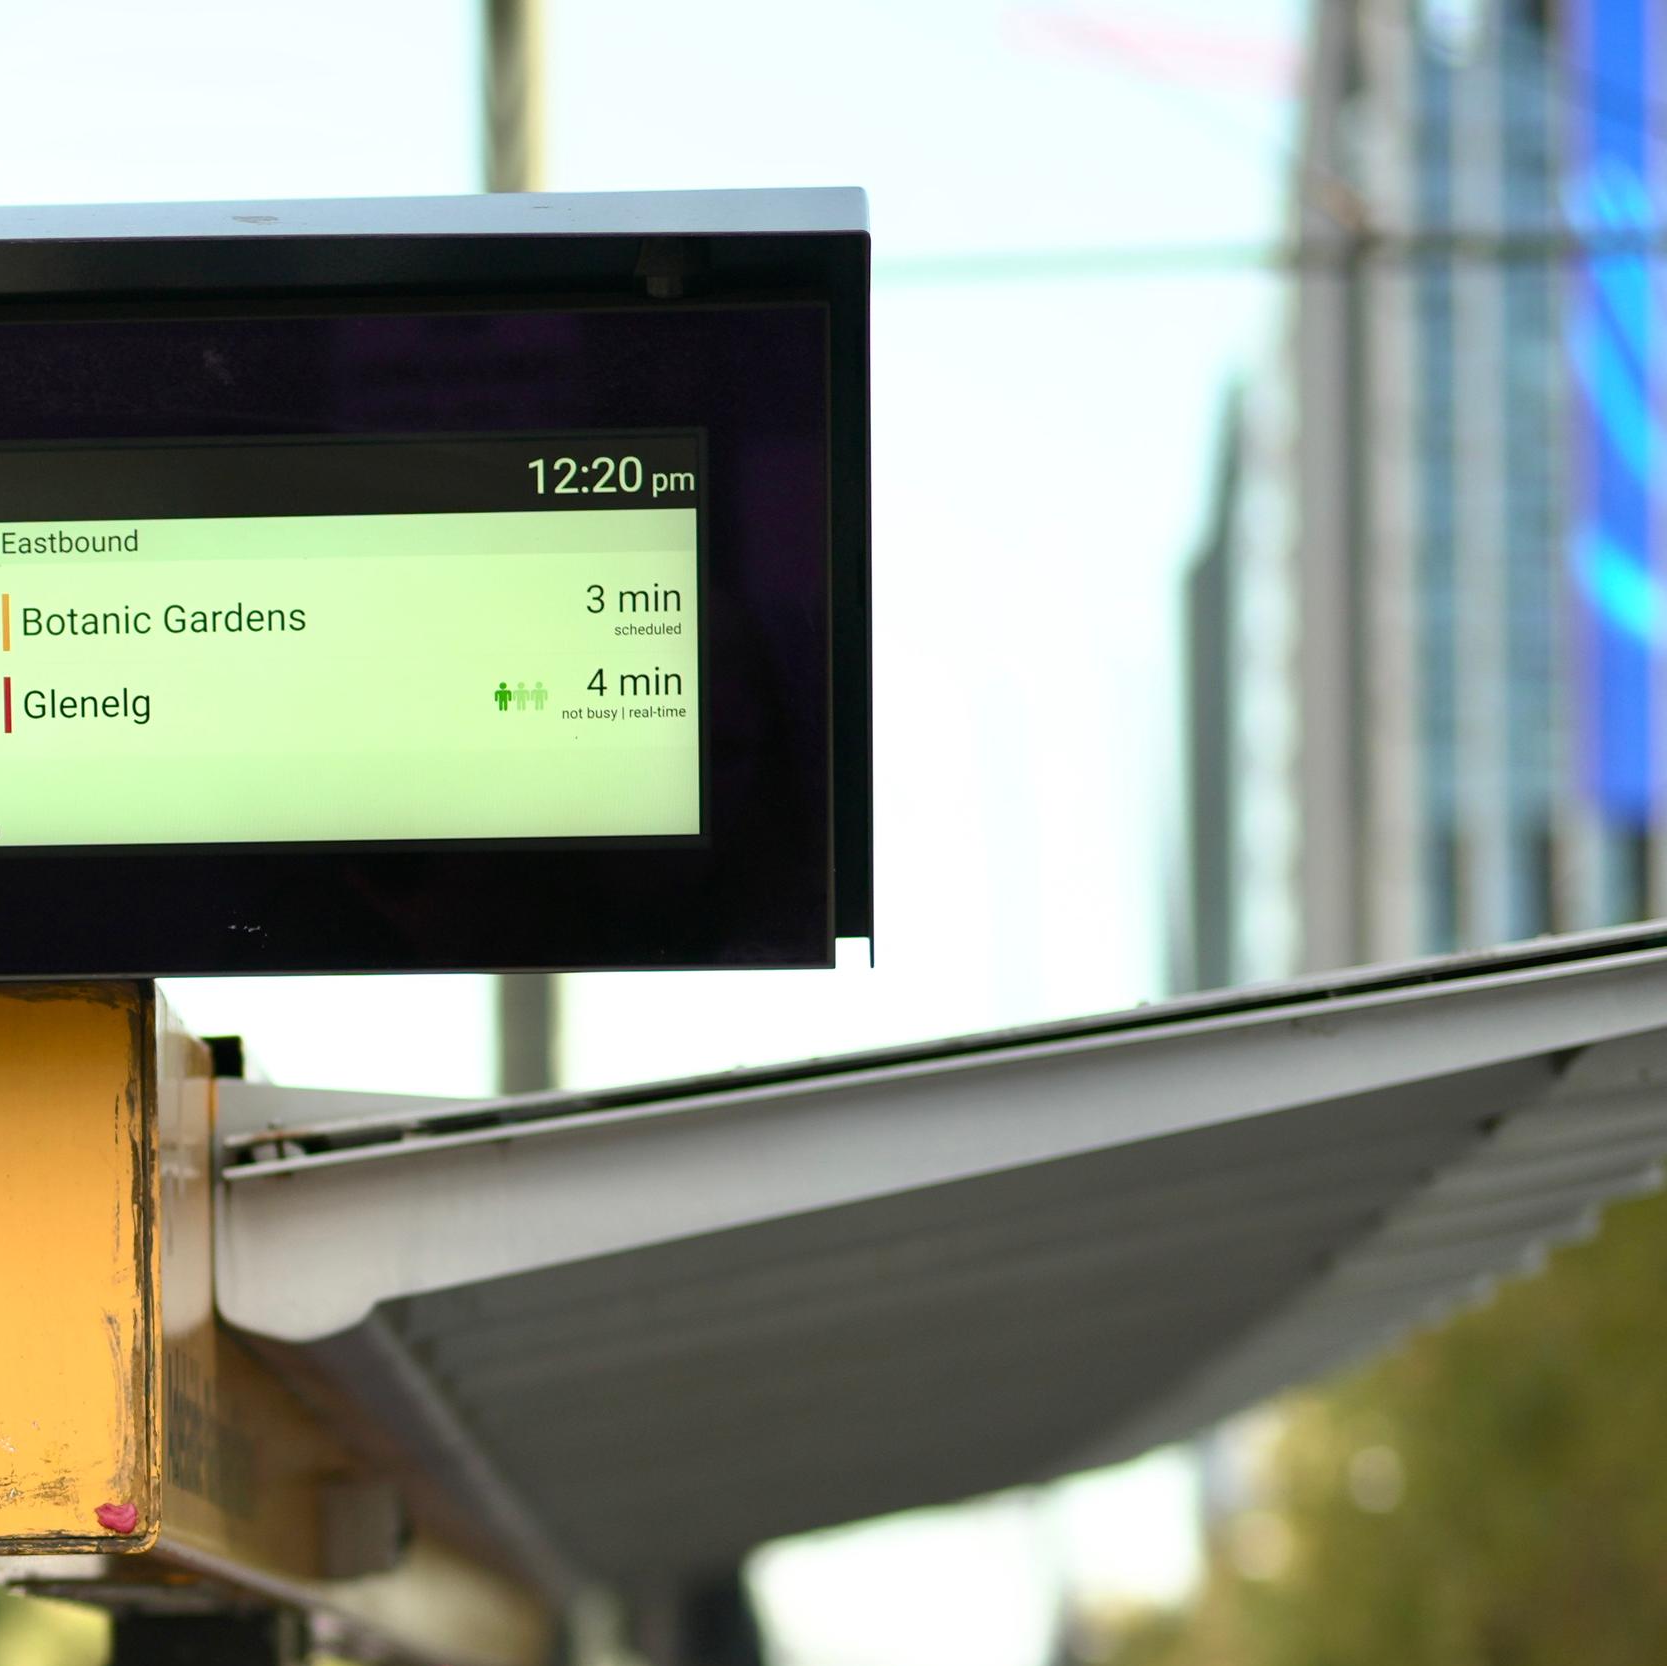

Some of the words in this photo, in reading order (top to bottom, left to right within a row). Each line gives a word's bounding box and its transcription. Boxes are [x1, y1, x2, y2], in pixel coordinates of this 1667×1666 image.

[528, 456, 643, 495] 12:20
[652, 472, 695, 498] pm
[2, 528, 139, 555] Eastbound
[586, 584, 605, 614] 3
[619, 582, 681, 613] min
[22, 605, 151, 637] Botanic
[163, 602, 306, 634] Gardens
[614, 622, 682, 636] scheduled
[586, 667, 608, 697] 4
[620, 666, 682, 697] min
[23, 687, 151, 725] Glenelg
[562, 708, 583, 720] not
[586, 707, 618, 722] busy
[629, 705, 687, 719] real-time
